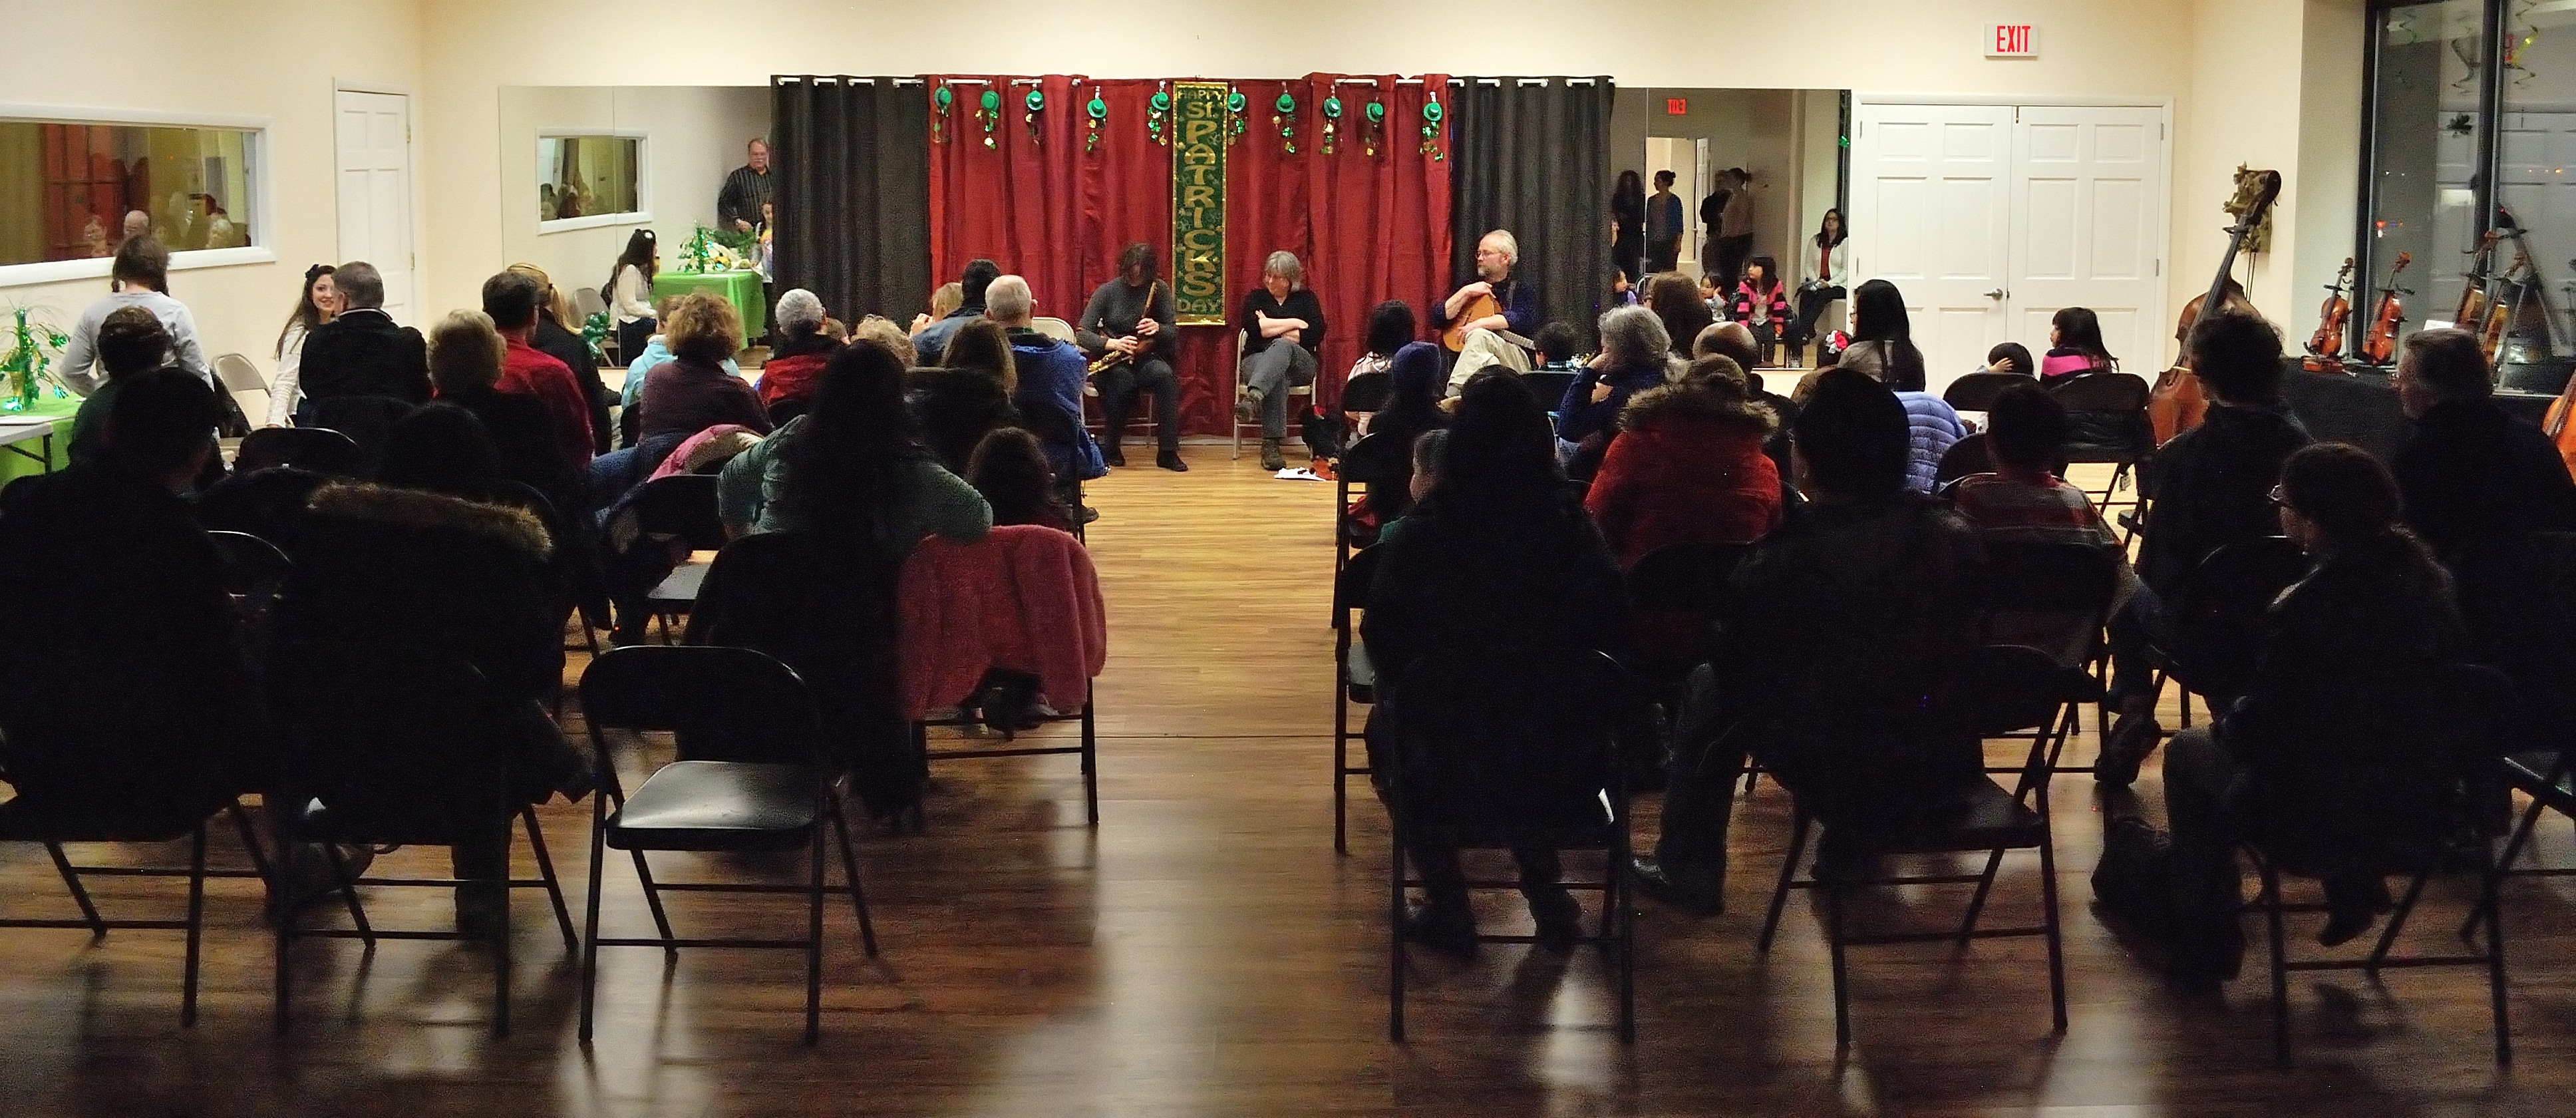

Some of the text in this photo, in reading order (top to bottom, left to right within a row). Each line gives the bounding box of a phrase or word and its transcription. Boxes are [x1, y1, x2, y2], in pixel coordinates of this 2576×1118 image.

[1997, 25, 2031, 53] EXIT
[1178, 89, 1225, 100] HAPPY
[1176, 298, 1221, 313] DAY
